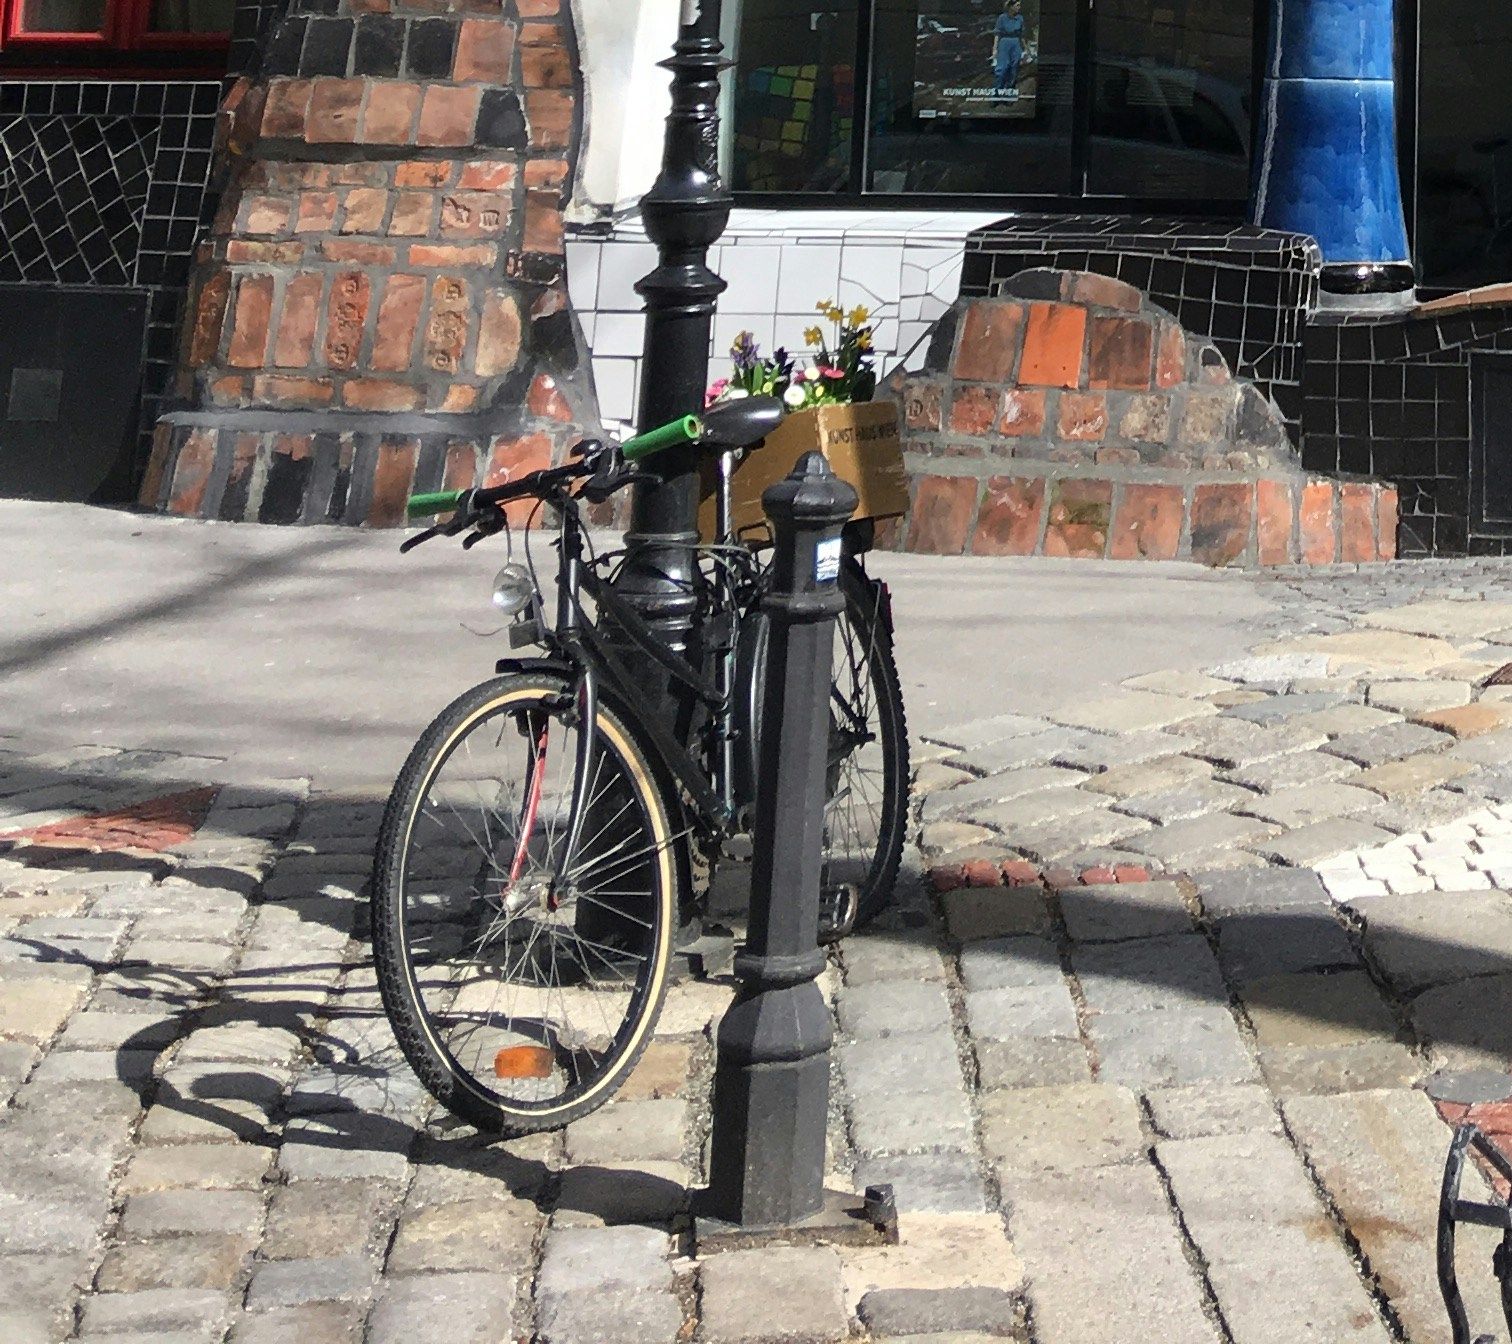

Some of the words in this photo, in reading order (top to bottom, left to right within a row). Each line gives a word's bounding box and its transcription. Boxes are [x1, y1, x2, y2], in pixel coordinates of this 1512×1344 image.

[942, 87, 972, 97] KUNST
[972, 87, 996, 97] HAUS
[997, 87, 1019, 97] WIEN
